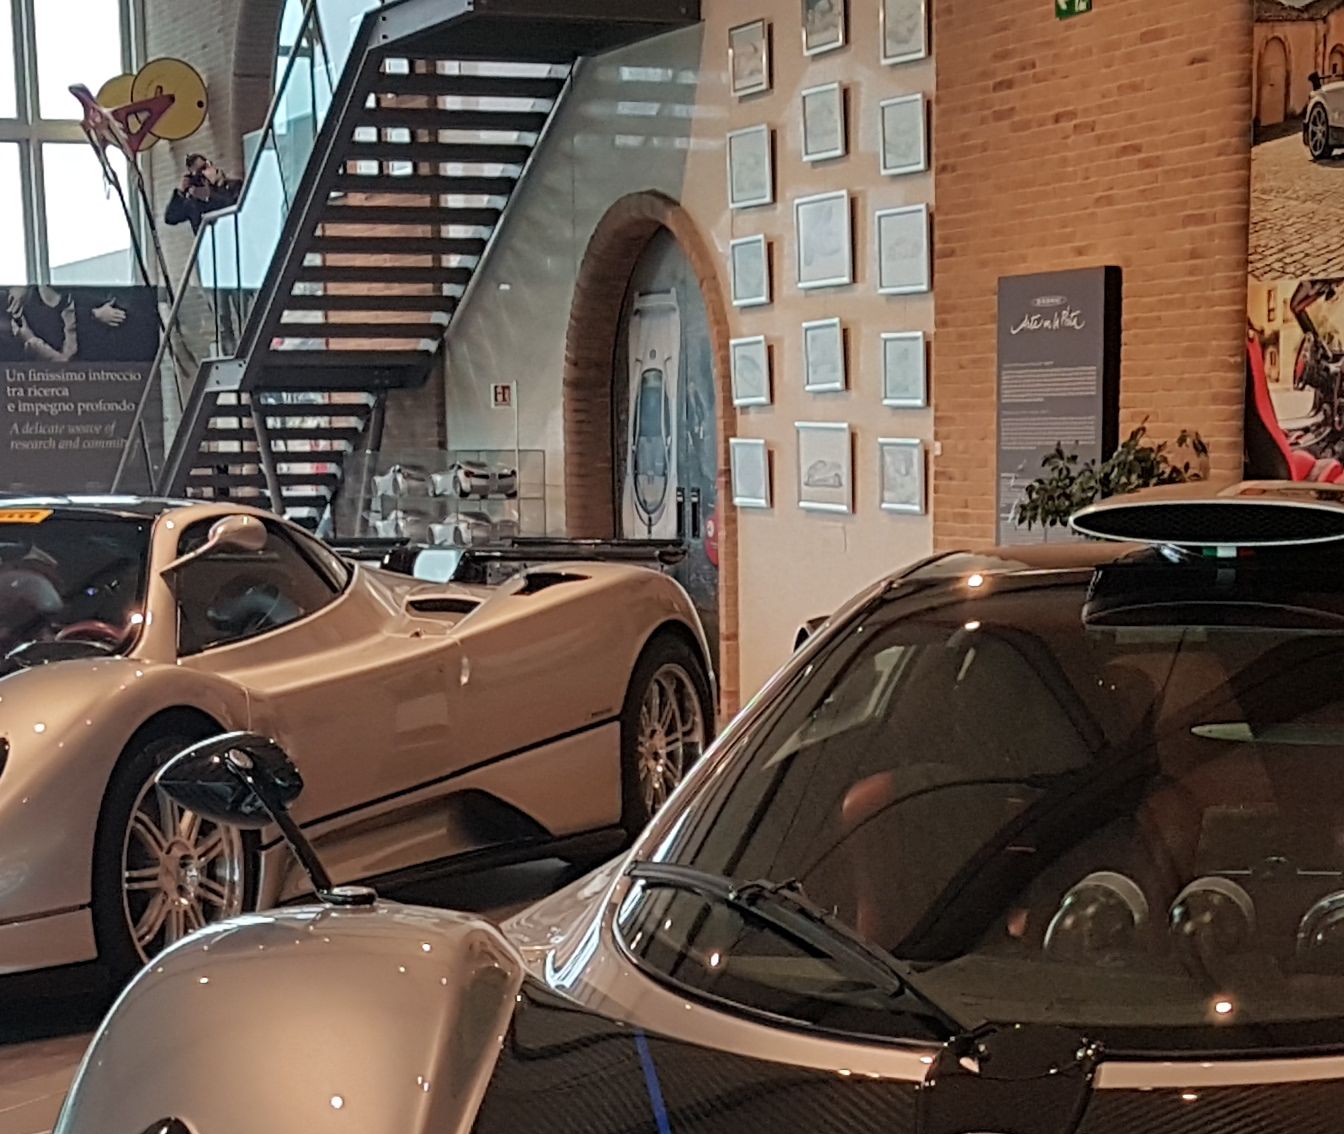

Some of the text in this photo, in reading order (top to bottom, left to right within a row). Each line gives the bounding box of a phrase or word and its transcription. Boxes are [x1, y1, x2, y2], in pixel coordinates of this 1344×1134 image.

[5, 368, 142, 382] Un finissimo intreccio
[6, 386, 69, 398] tra ricerca
[7, 399, 136, 416] e impegno profondo
[9, 422, 21, 435] A
[22, 421, 65, 435] delicate
[104, 420, 117, 437] of
[10, 437, 57, 450] research
[58, 436, 81, 449] and
